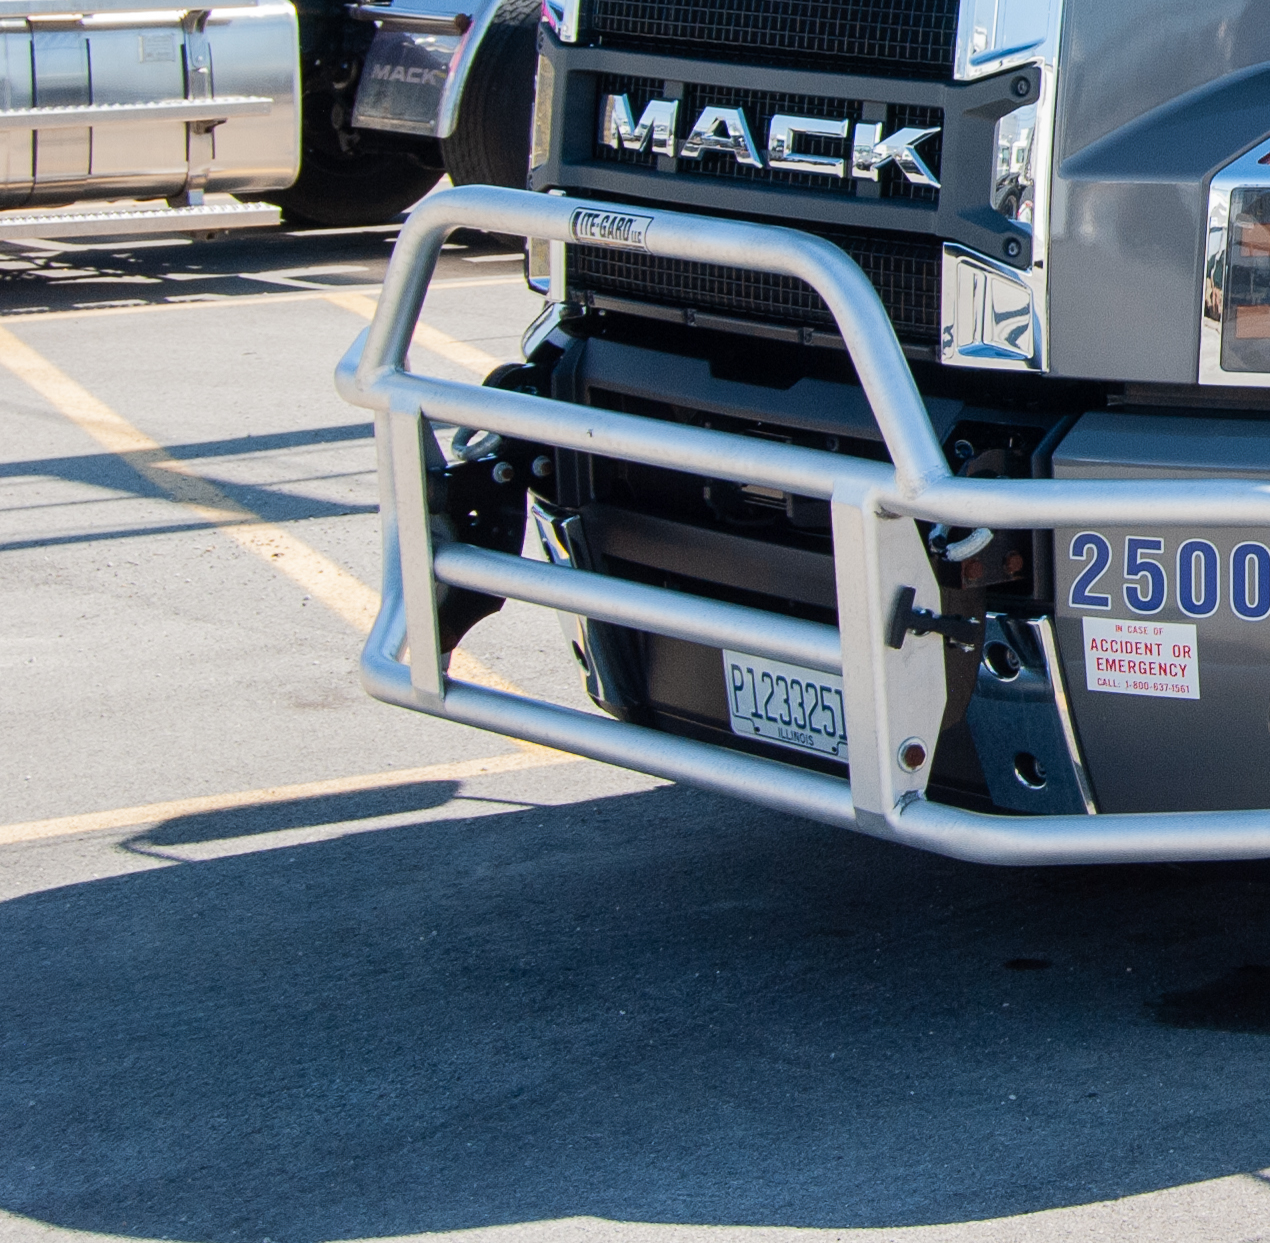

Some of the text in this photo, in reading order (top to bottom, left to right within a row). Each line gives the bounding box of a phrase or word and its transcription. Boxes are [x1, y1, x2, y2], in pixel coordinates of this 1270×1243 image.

[371, 64, 441, 85] MACK
[600, 93, 941, 189] MACK
[1115, 624, 1164, 636] IN CASE OF
[1090, 638, 1192, 659] ACCIDENT OR
[1096, 657, 1188, 678] EMERGENCY
[1097, 677, 1190, 694] CALL: 1-800-637-1561
[731, 663, 847, 741] P1233251
[778, 727, 815, 746] ILLINOIS
